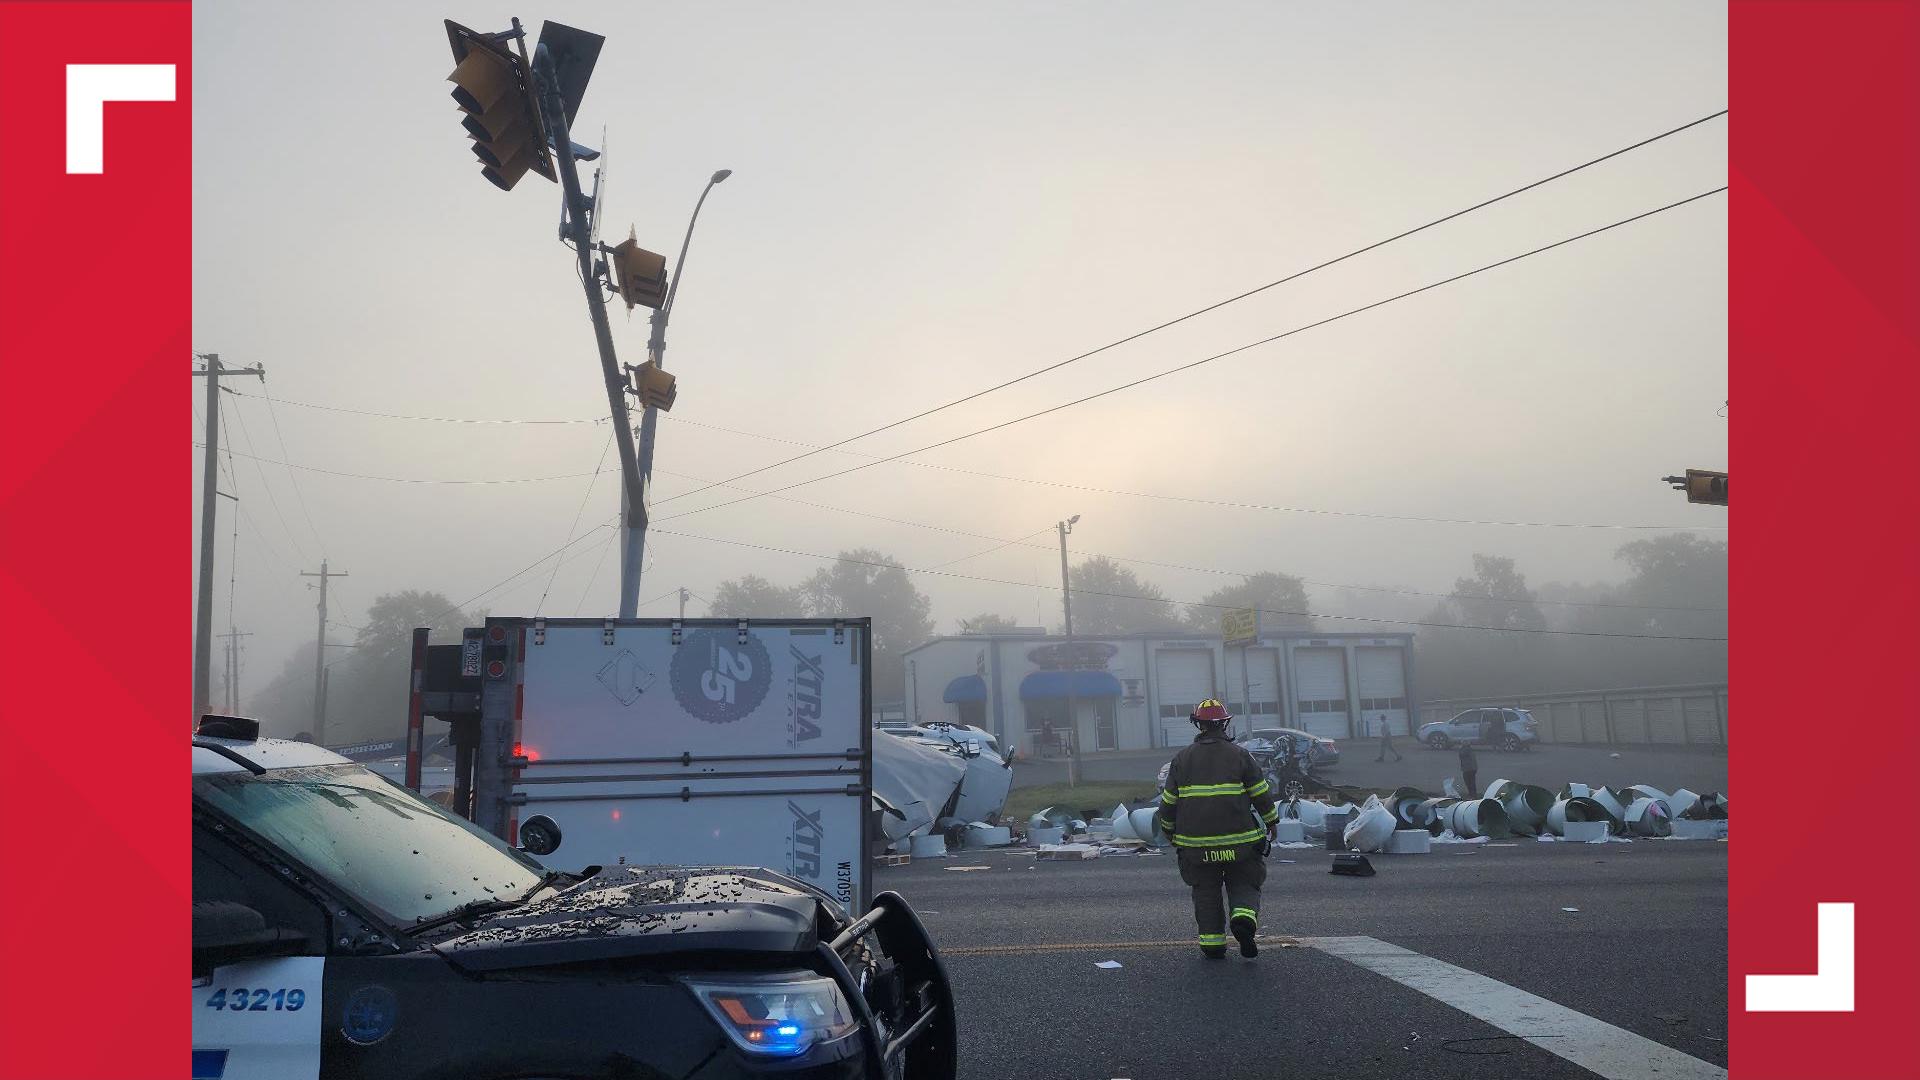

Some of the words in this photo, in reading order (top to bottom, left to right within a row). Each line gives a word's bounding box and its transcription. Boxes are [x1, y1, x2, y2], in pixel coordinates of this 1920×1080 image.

[700, 646, 753, 705] 25
[790, 643, 825, 742] XTRA
[786, 677, 794, 750] LEASE
[788, 800, 823, 879] XTR
[1203, 850, 1209, 862] J
[1210, 849, 1236, 862] DUNN
[837, 861, 851, 903] W37059
[206, 987, 306, 1012] 43219
